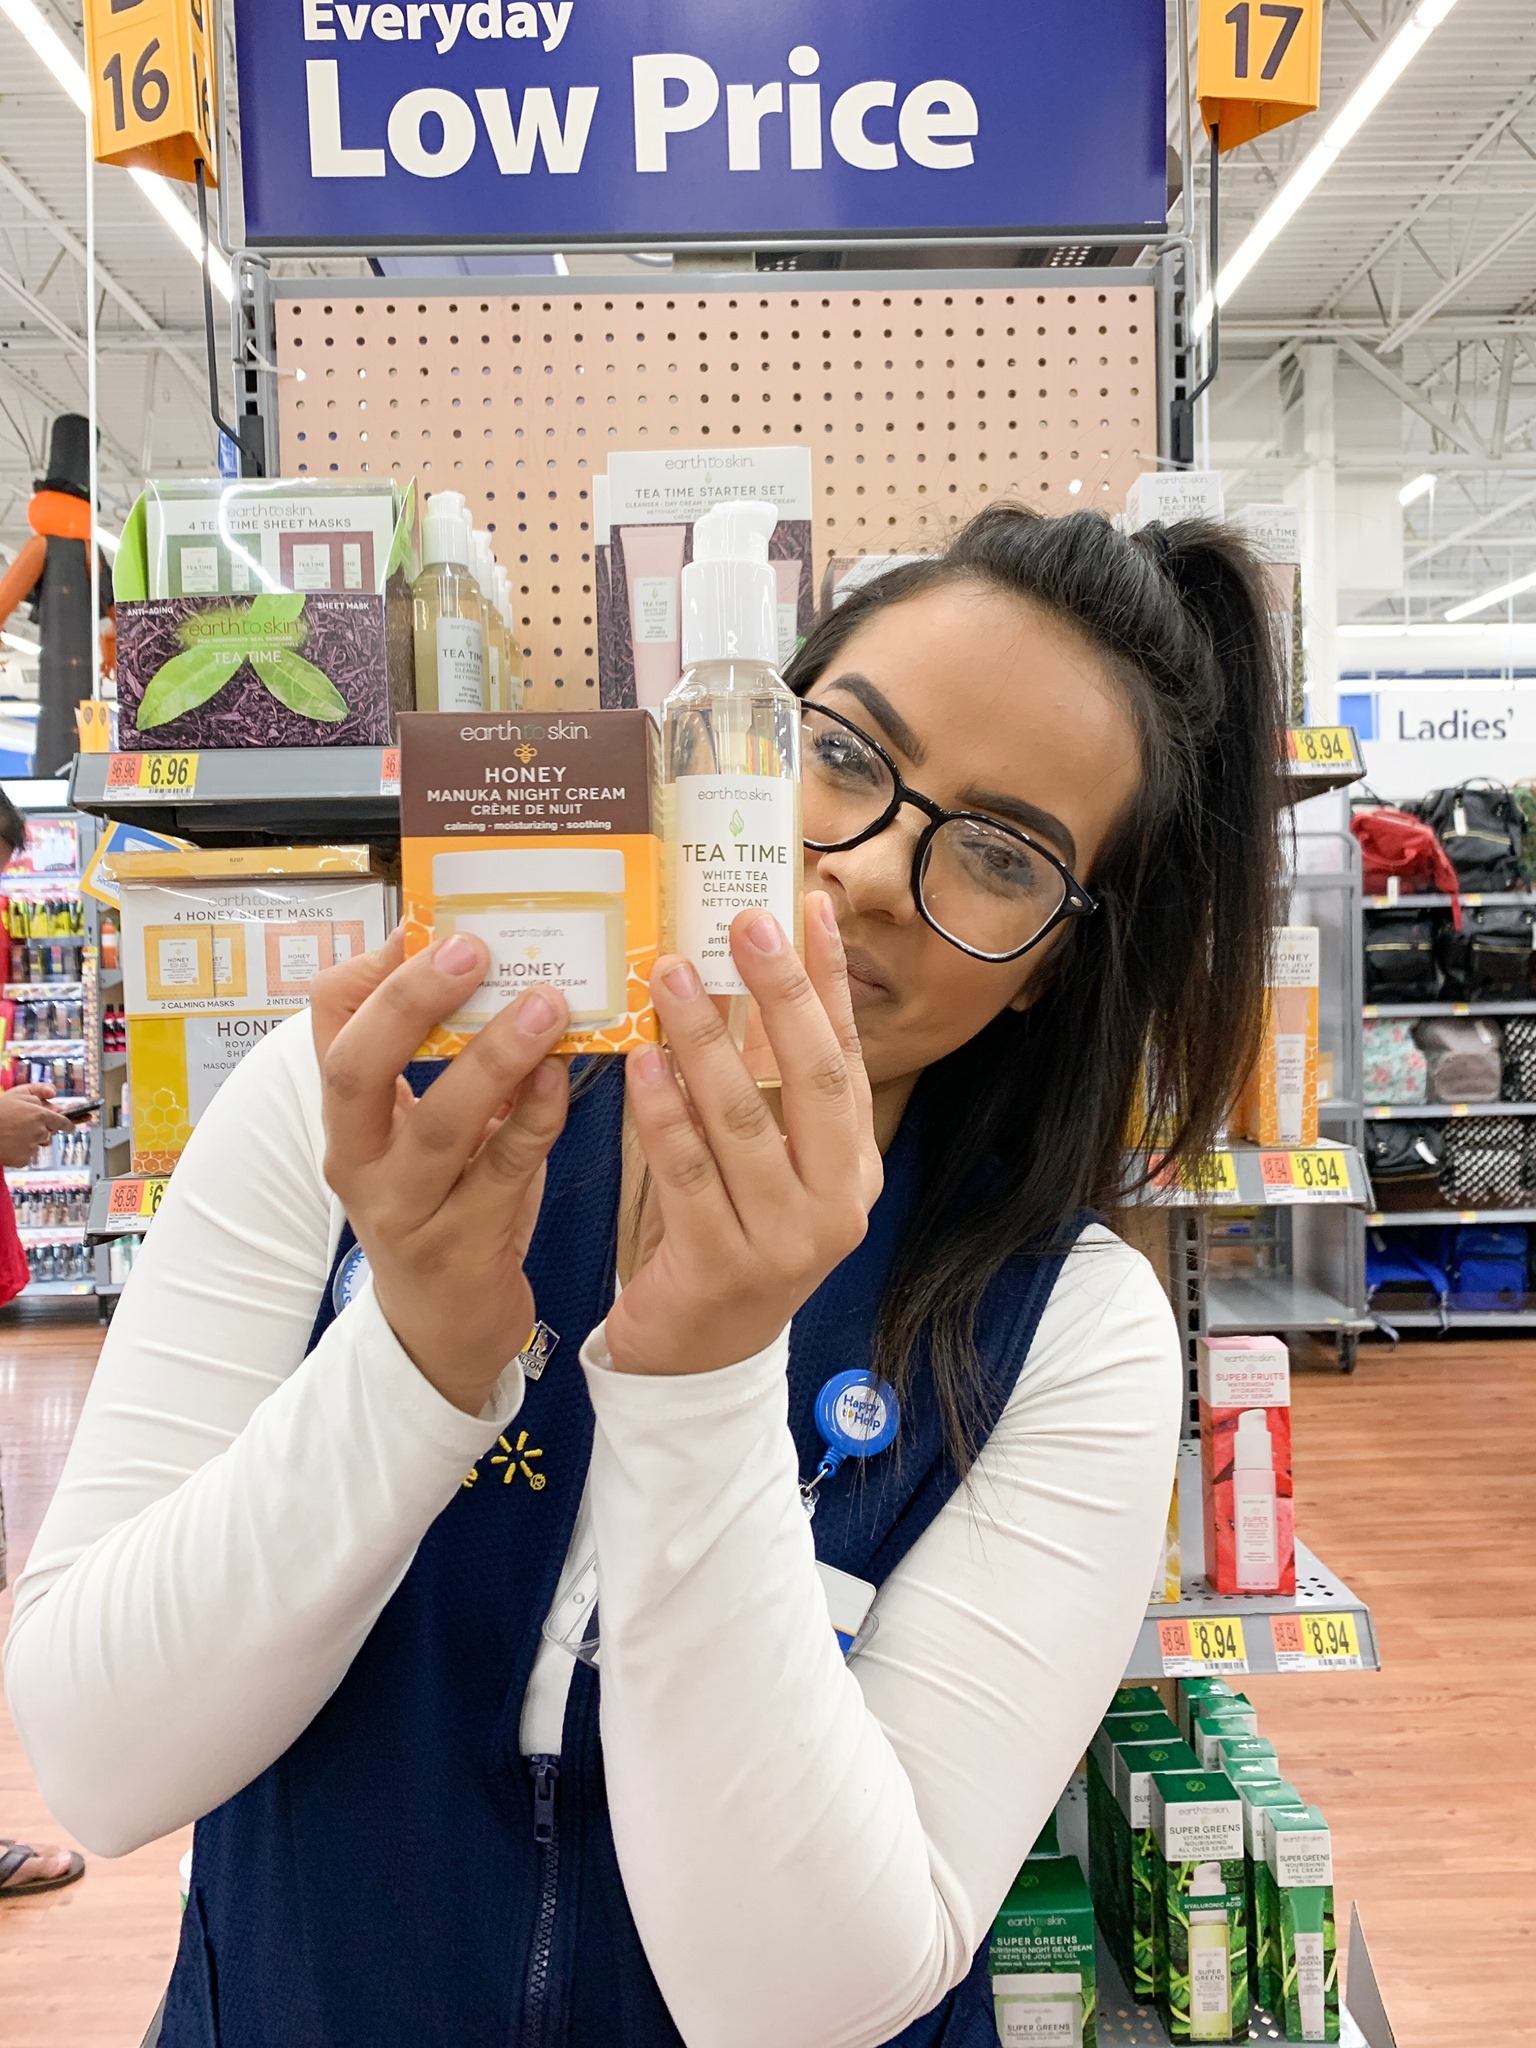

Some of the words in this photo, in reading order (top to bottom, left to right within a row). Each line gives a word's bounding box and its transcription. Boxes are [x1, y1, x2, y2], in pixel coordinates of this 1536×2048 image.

[303, 0, 573, 55] Everyday
[1225, 1, 1303, 80] 17
[103, 37, 169, 132] 16
[305, 59, 600, 178] Low
[632, 45, 979, 172] Price
[635, 488, 660, 498] TEA
[664, 487, 694, 498] TIME
[699, 486, 756, 497] STARTER
[761, 485, 785, 496] SET
[1158, 496, 1178, 505] TEA
[1181, 495, 1206, 504] TIME
[188, 521, 197, 531] 4
[230, 519, 259, 530] TIME
[263, 518, 304, 529] SHEET
[308, 518, 352, 529] MASKS
[1255, 528, 1273, 537] TEA
[1277, 528, 1297, 537] TIME
[127, 606, 174, 617] ANTI-AGING
[317, 602, 345, 610] SHEET
[346, 602, 370, 610] MASK
[213, 651, 243, 665] TEA
[245, 650, 283, 663] TIME
[442, 648, 466, 659] TEA
[1398, 707, 1514, 741] Ladies'
[147, 757, 189, 785] $6.96
[484, 766, 567, 784] HONEY
[427, 788, 500, 803] MANUKA
[506, 787, 560, 801] NIGHT
[565, 786, 626, 801] CREAM
[470, 802, 521, 816] CRÈME
[524, 803, 545, 815] DE
[549, 803, 583, 815] NUIT
[444, 822, 486, 832] calming
[494, 821, 558, 831] moisturizing
[566, 820, 612, 830] soothing
[682, 844, 726, 862] TEA
[734, 844, 787, 864] TIME
[702, 870, 742, 881] WHITE
[745, 871, 769, 881] TEA
[702, 882, 768, 893] CLEANSER
[701, 898, 769, 908] NETTOYANT
[173, 912, 182, 921] 4
[186, 910, 235, 921] HONEY
[239, 908, 283, 919] SHEET
[288, 907, 333, 918] MASKS
[701, 949, 725, 959] pore
[499, 962, 565, 977] HONEY
[554, 979, 588, 987] CREAM
[167, 1001, 206, 1009] CALMING
[207, 1000, 235, 1008] MASKS
[272, 998, 304, 1006] INTENSE
[1297, 1156, 1339, 1186] $8.94
[114, 1188, 138, 1207] $6.96
[1215, 1373, 1248, 1381] SUPER
[1250, 1372, 1285, 1380] FRUITS
[843, 1394, 880, 1416] Happy
[854, 1411, 880, 1431] Help
[1194, 1624, 1236, 1659] $8.94
[1307, 1620, 1349, 1655] $8.94
[1169, 1825, 1200, 1835] SUPER
[1202, 1823, 1241, 1834] GREENS
[1184, 1902, 1224, 1910] HYALURONIC
[996, 1937, 1031, 1946] SUPER
[1034, 1935, 1078, 1945] GREENS
[1051, 1945, 1066, 1953] GEL
[1067, 1944, 1093, 1952] CREAM
[1007, 2024, 1034, 2032] SUPER
[1036, 2023, 1070, 2031] GREENS
